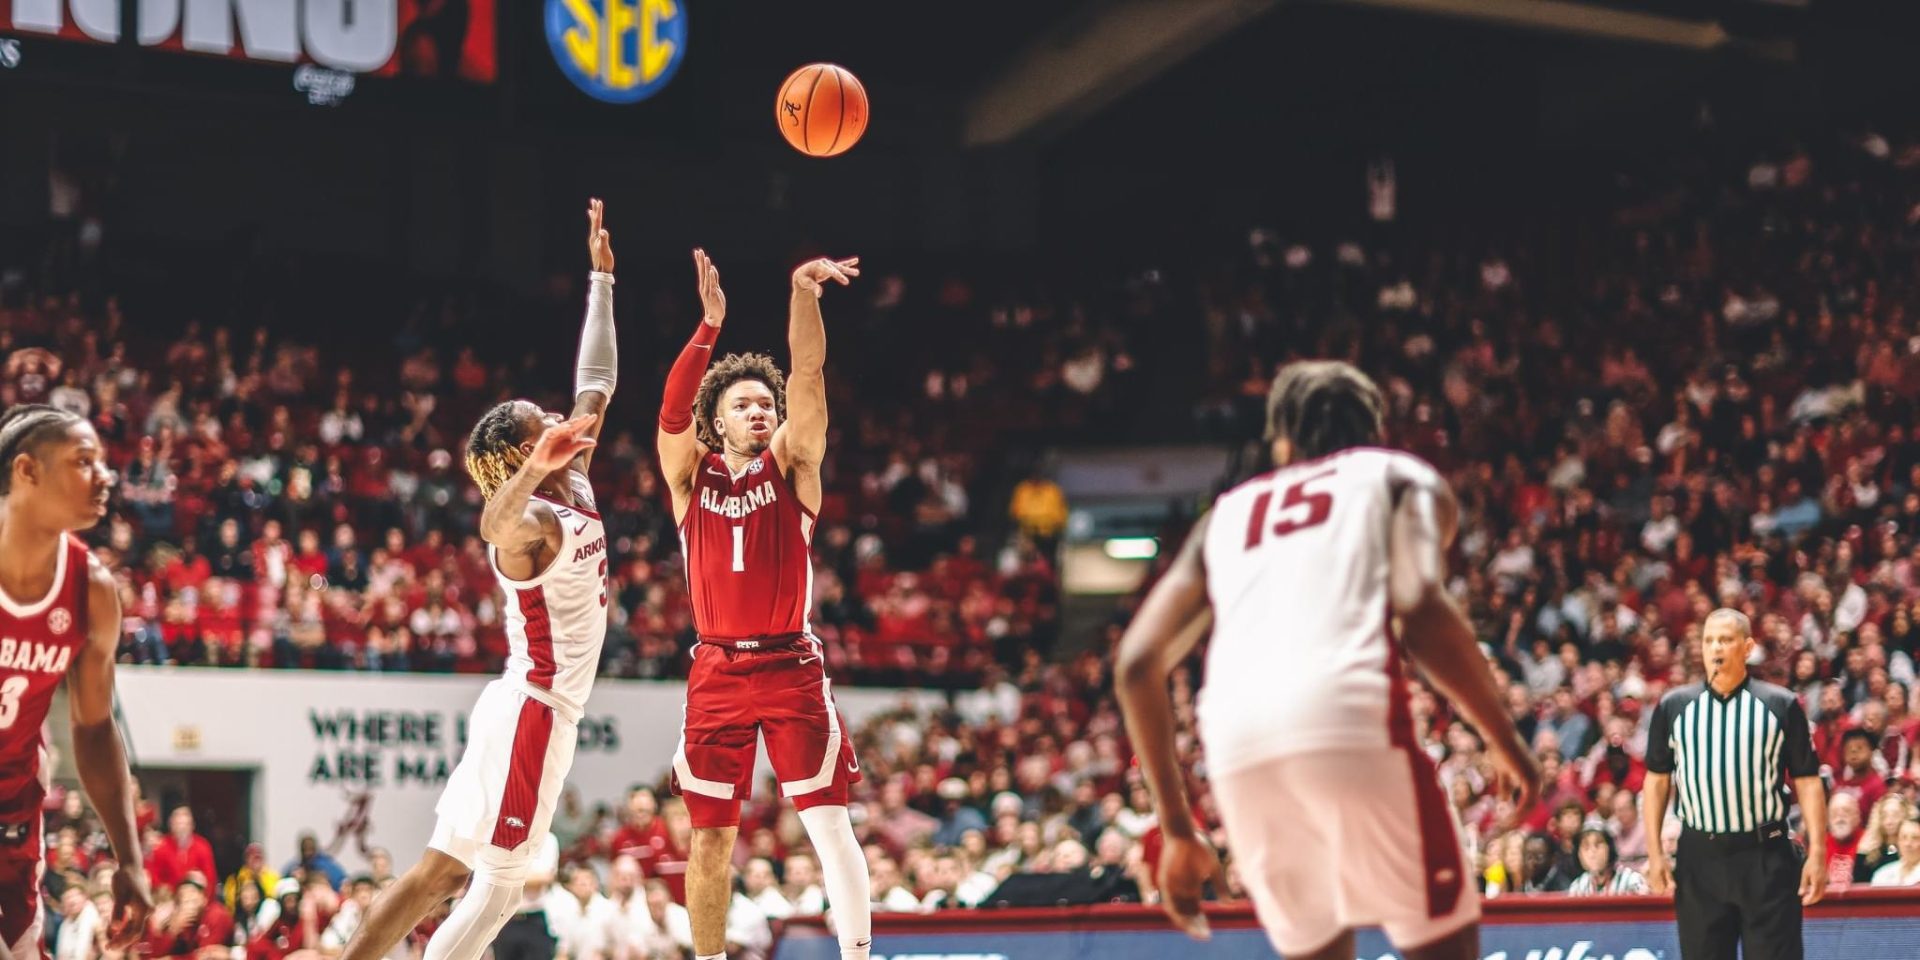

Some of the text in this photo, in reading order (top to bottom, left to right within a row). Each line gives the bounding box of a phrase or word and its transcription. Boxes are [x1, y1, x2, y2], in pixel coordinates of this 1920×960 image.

[561, 0, 678, 90] SEC
[700, 480, 777, 519] ALABAMA
[1244, 468, 1338, 552] 15
[731, 525, 746, 572] 1
[308, 708, 444, 747] WHERE
[308, 752, 456, 786] ARE MA
